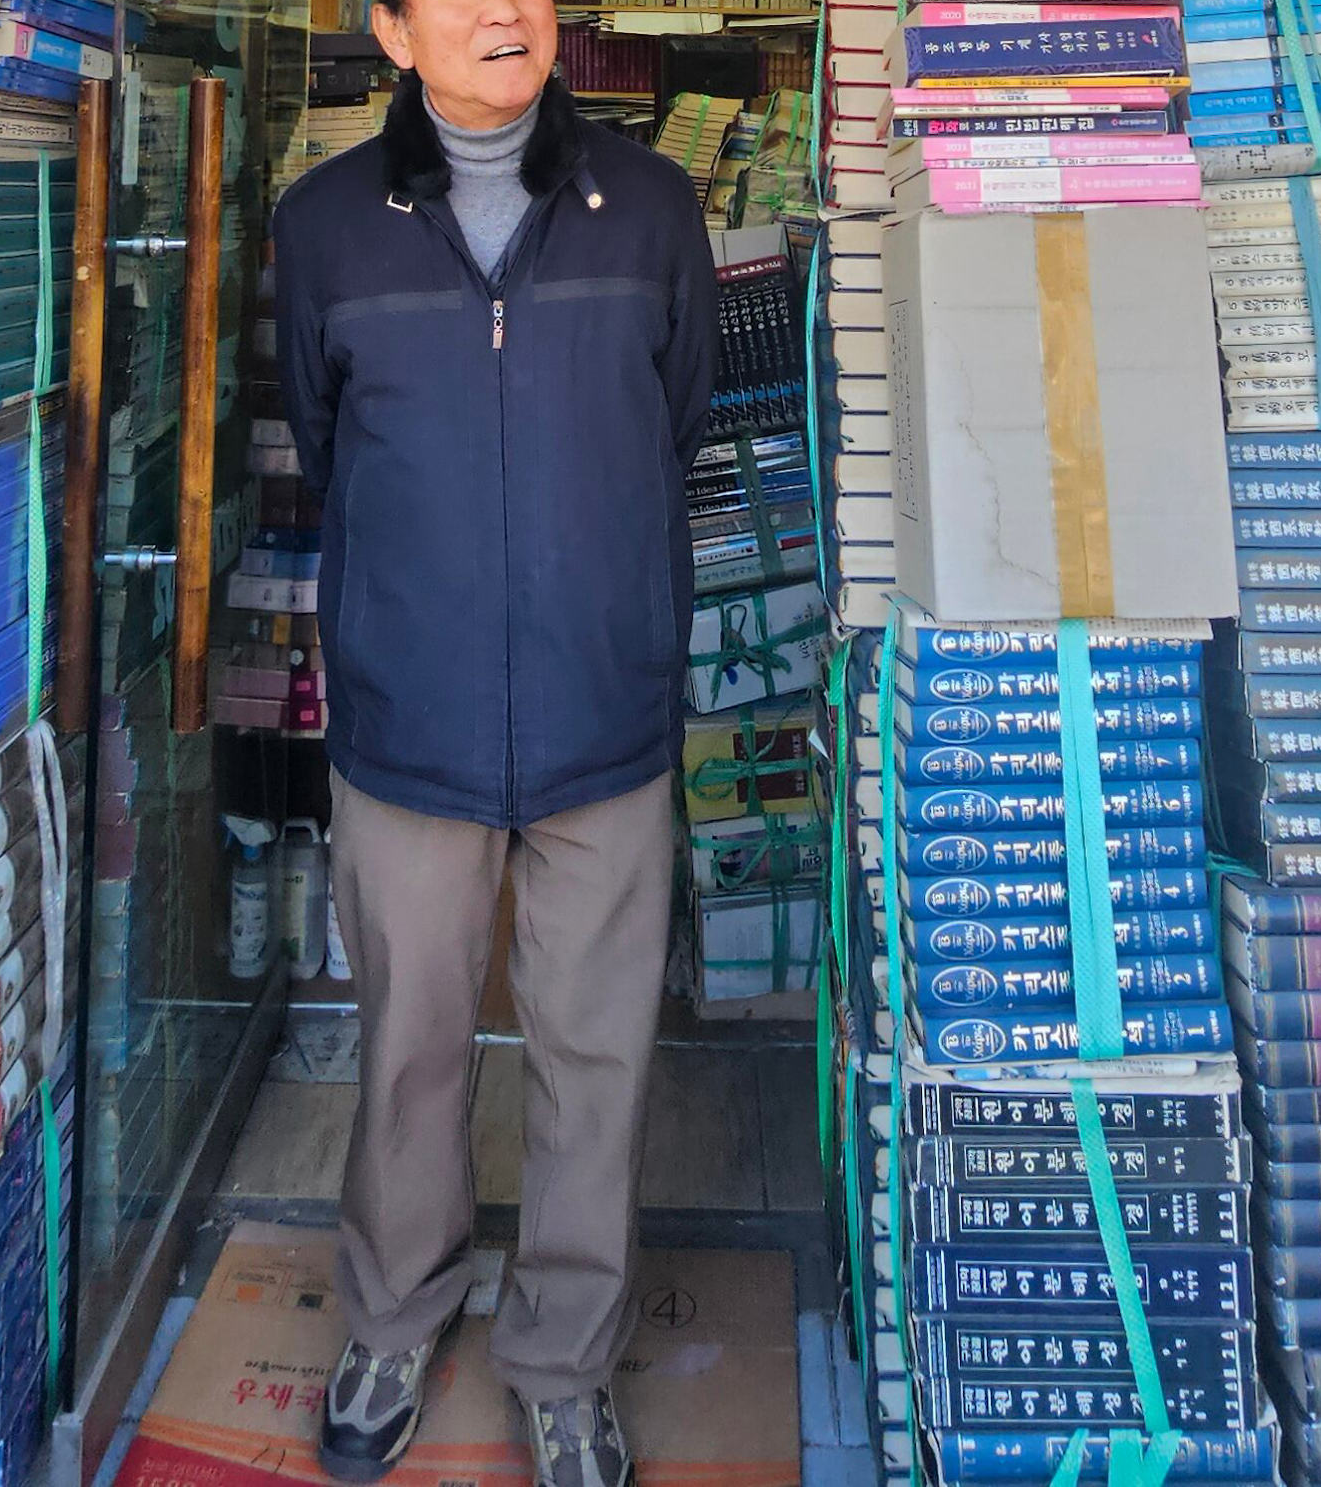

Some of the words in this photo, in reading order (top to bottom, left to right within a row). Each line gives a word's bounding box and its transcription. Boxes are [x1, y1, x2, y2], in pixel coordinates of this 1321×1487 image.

[981, 1098, 1133, 1123] 원어분해경
[995, 1148, 1144, 1173] 원어분해경
[993, 1201, 1145, 1227] 원어분해경
[989, 1270, 1144, 1296] 원어분해성
[990, 1337, 1130, 1365] 원어분해성
[995, 1389, 1143, 1417] 원어분해성
